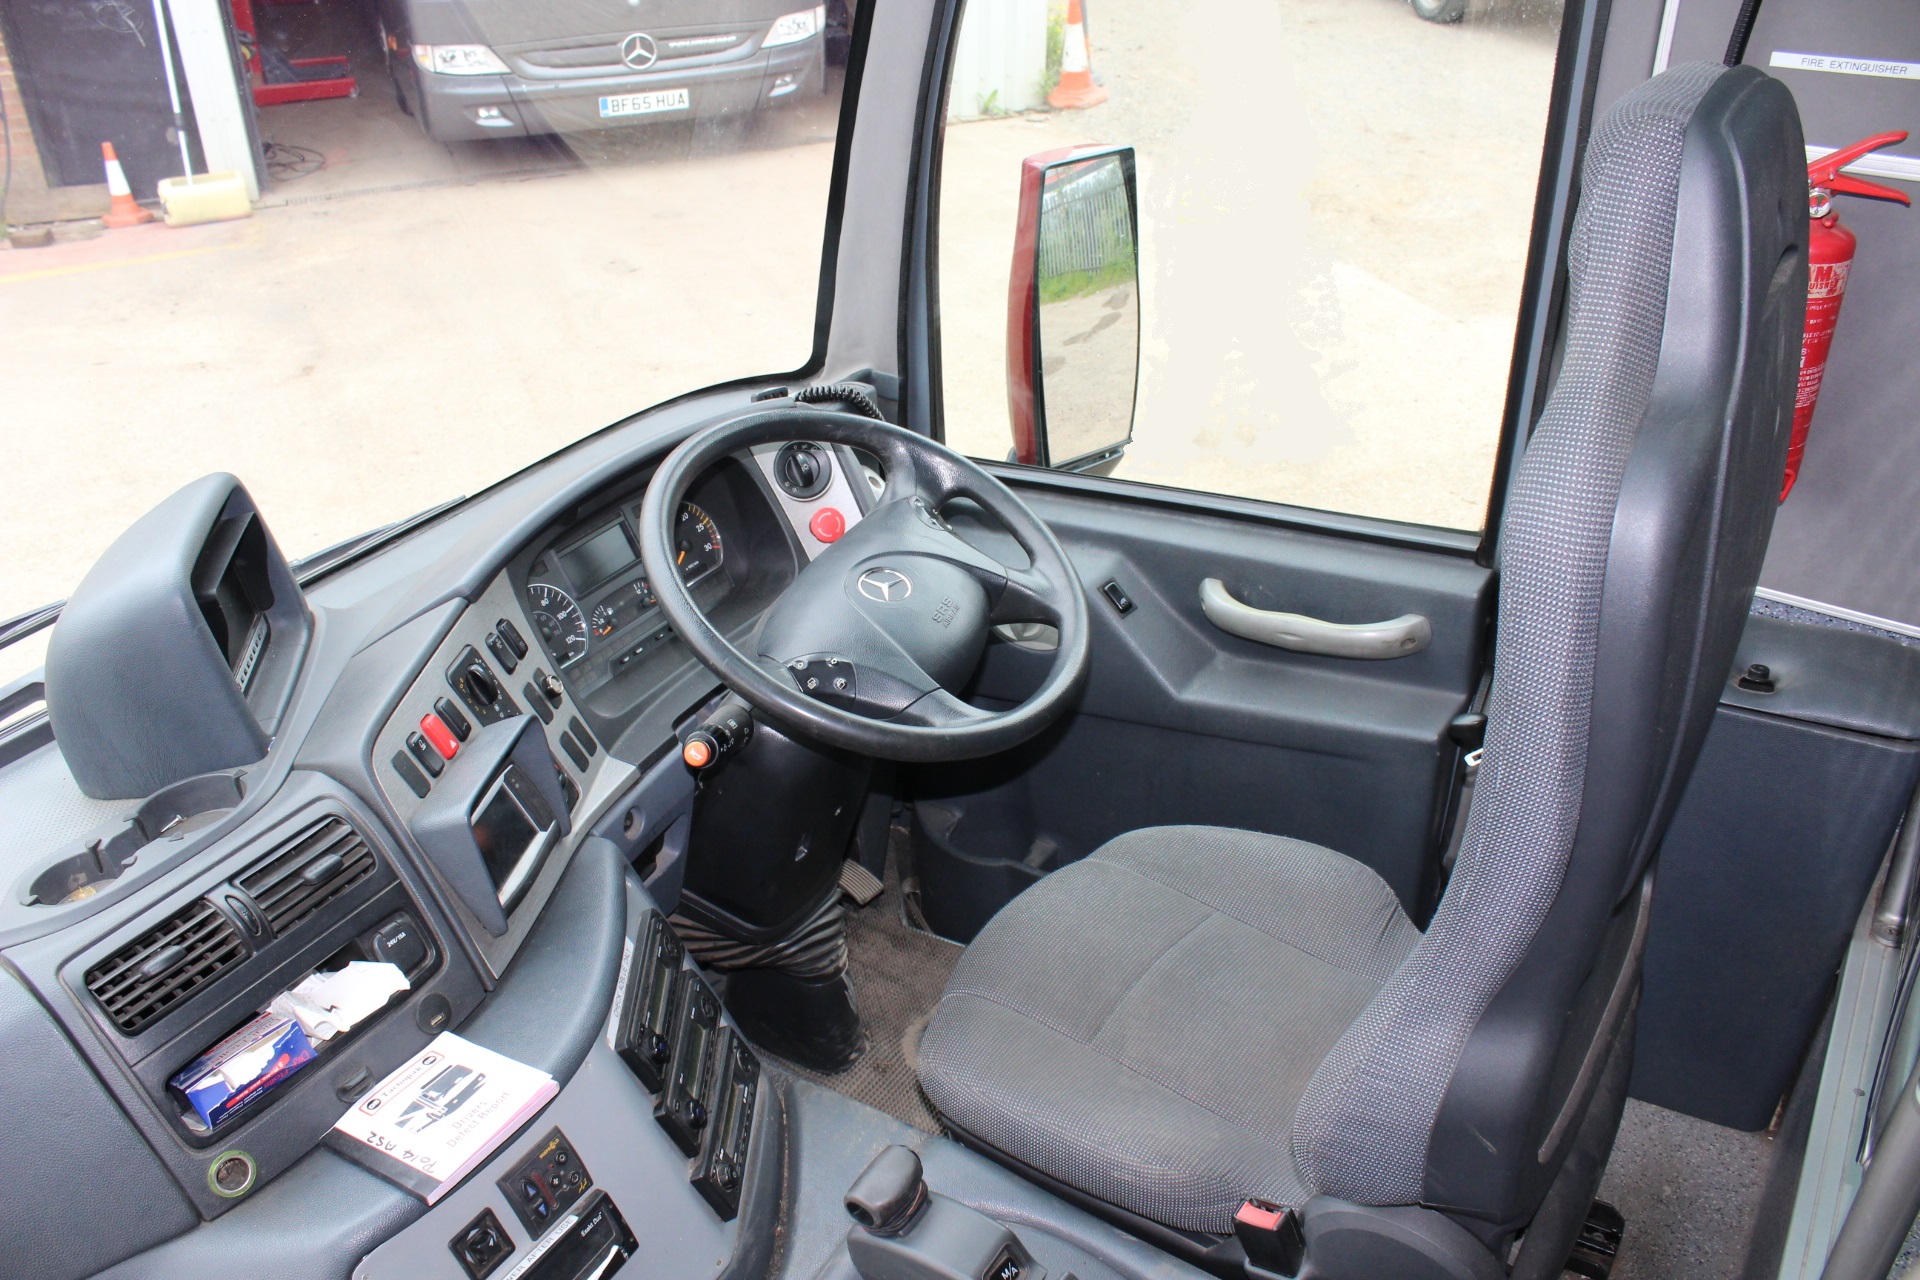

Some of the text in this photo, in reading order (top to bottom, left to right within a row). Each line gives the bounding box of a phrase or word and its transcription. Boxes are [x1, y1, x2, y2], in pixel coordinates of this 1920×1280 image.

[1801, 58, 1908, 75] FIRE EXTINGUISHER
[611, 92, 686, 113] BF65 HUA
[681, 512, 689, 522] 20
[696, 523, 705, 533] 25
[704, 543, 713, 552] 30
[541, 597, 550, 607] 80
[932, 597, 954, 624] SRS
[557, 610, 567, 621] 100
[565, 634, 576, 645] 120
[381, 1067, 422, 1097] Tachopak
[447, 1092, 510, 1148] Defect Report
[452, 1101, 487, 1130] Drivers
[527, 1237, 555, 1263] AFTER
[555, 1217, 575, 1235] USE
